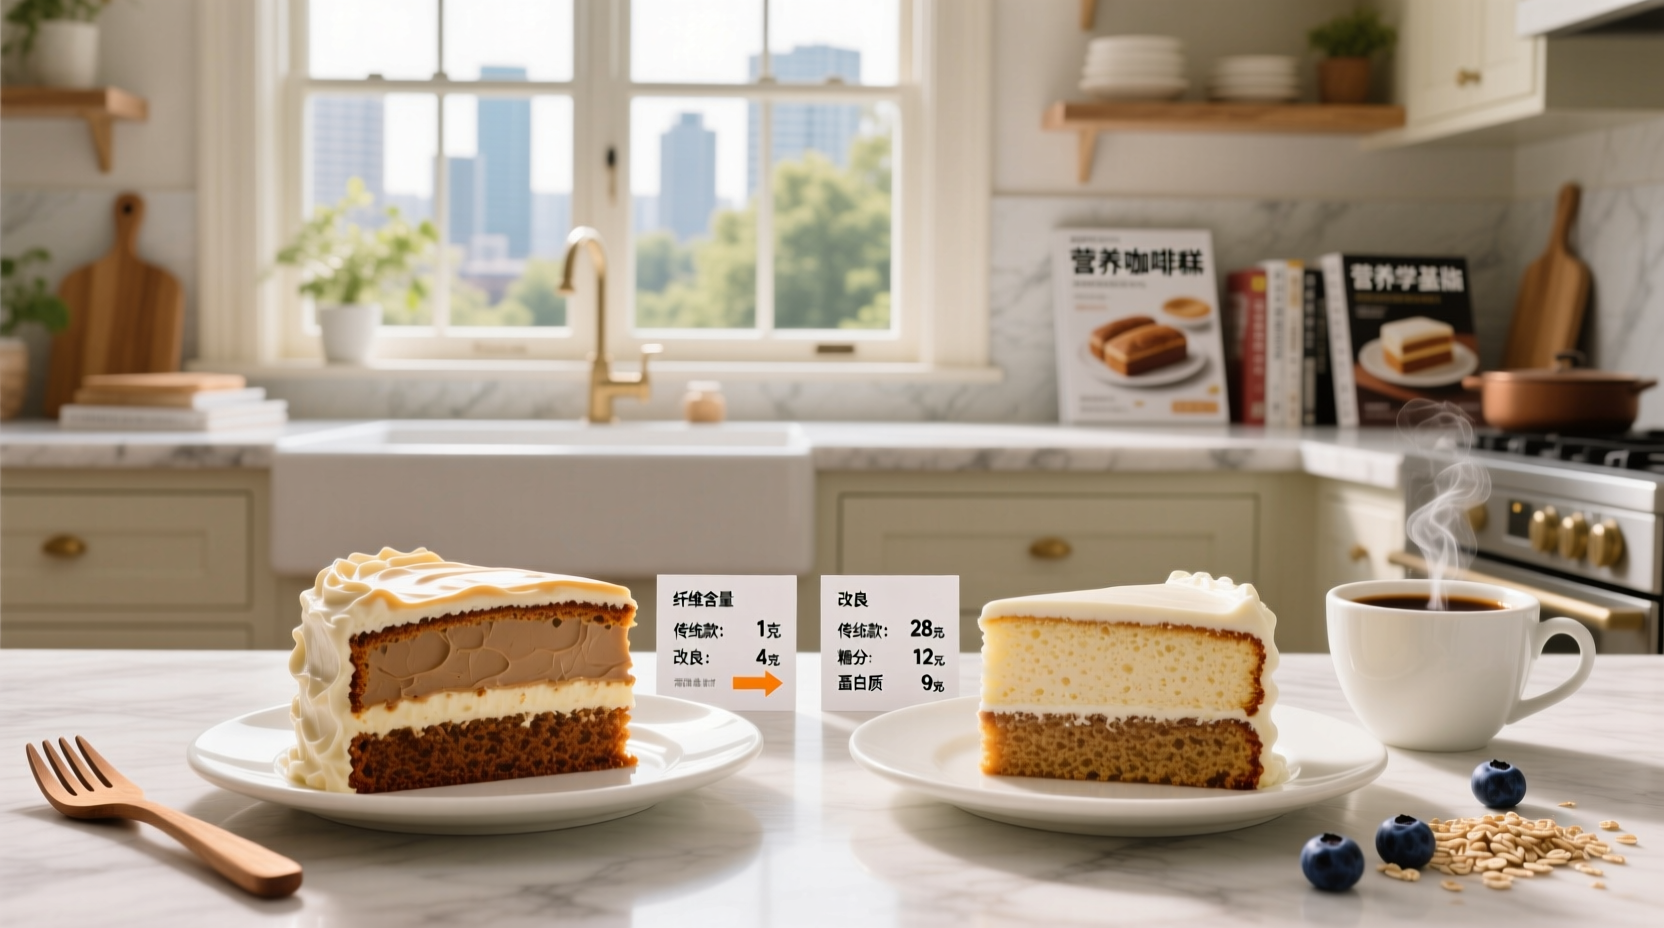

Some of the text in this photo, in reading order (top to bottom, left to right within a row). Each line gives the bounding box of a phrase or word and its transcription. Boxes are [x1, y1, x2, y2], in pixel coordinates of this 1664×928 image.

[673, 591, 733, 607] 纤维含量
[838, 591, 868, 607] 改良
[757, 620, 781, 638] 1克
[674, 648, 780, 666] 改良： 4克
